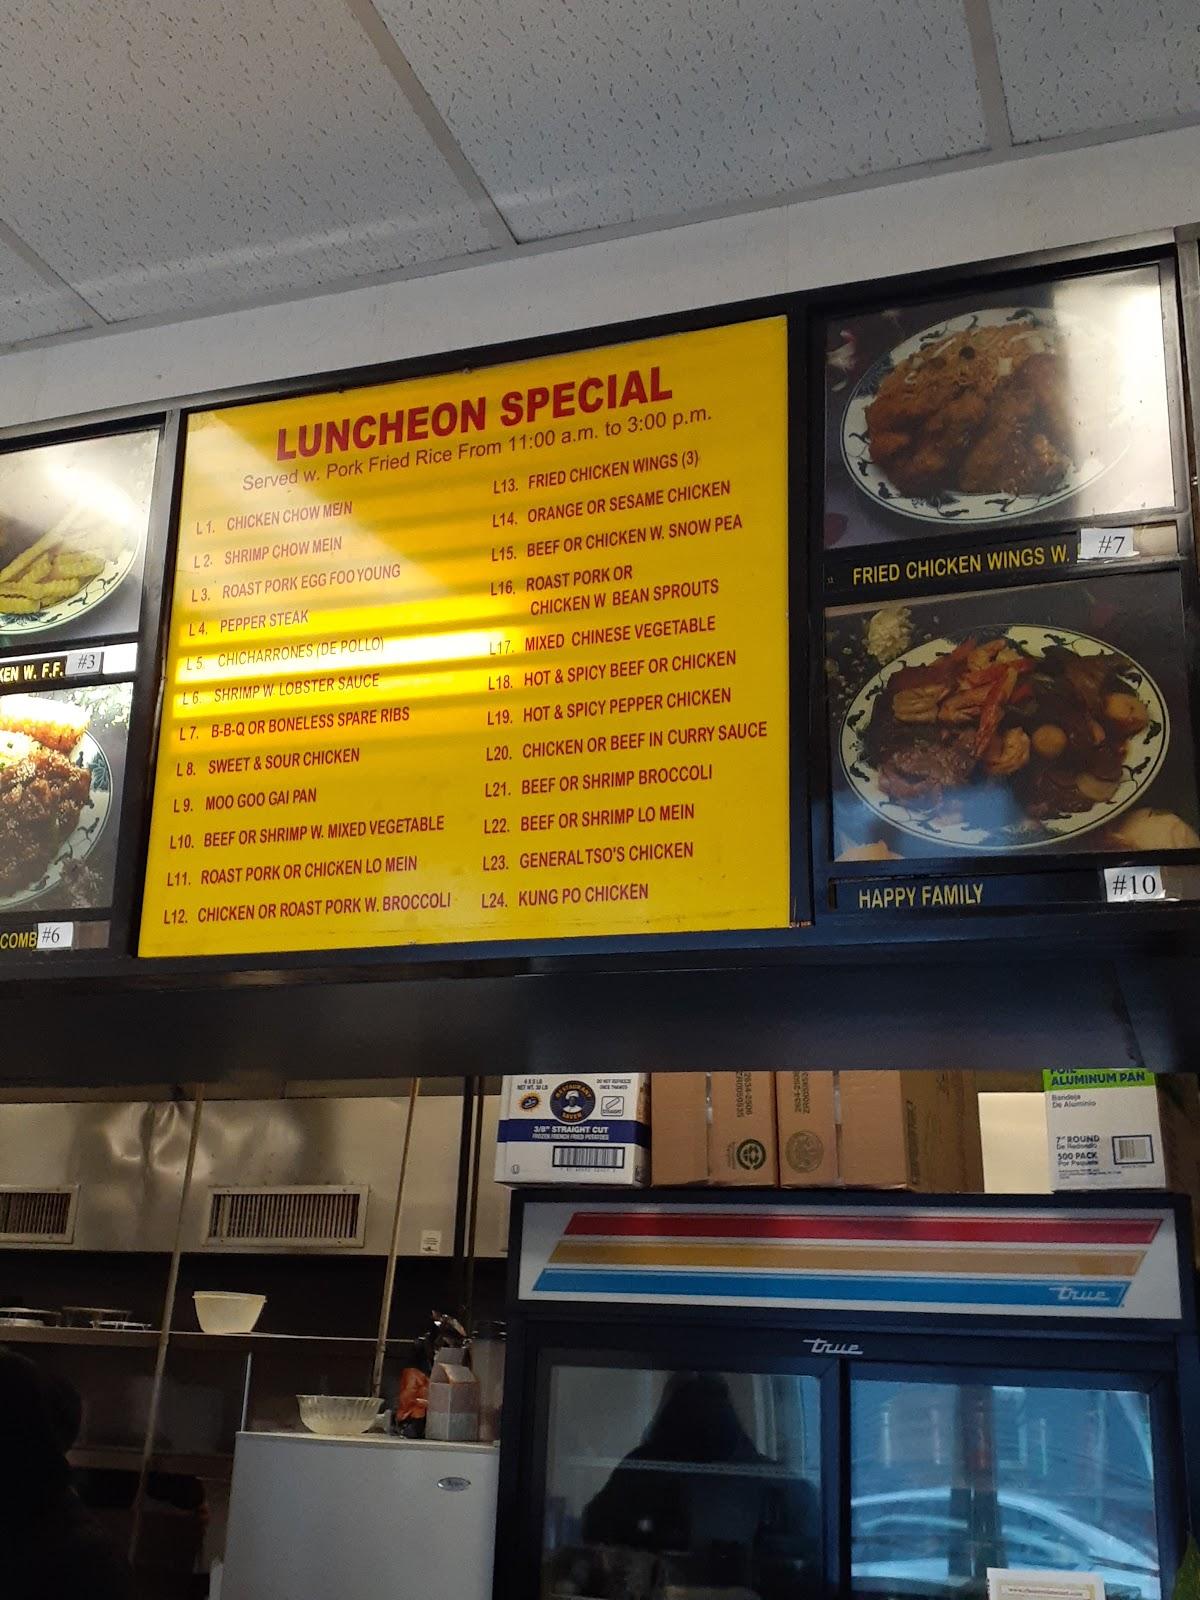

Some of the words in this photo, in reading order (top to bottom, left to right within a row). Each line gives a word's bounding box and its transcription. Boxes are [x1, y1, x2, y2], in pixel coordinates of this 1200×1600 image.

[276, 396, 486, 461] LUNCHEON
[500, 366, 672, 426] SPECIAL
[242, 468, 298, 491] Served
[303, 468, 320, 483] w.
[326, 459, 363, 478] Pork
[368, 451, 410, 472] Fried
[415, 448, 452, 465] Rice
[458, 442, 501, 459] From
[508, 429, 555, 451] 11:00
[560, 427, 598, 443] a.m.
[604, 421, 621, 436] to
[627, 411, 666, 432] 3:00
[672, 408, 711, 429] p.m.
[528, 470, 566, 488] FRIED
[569, 460, 629, 482] CHICKEN
[632, 453, 678, 472] WINGS
[681, 450, 698, 469] (3)
[226, 511, 280, 530] CHICKEN
[282, 505, 320, 523] CHOW
[322, 500, 352, 517] MEIN
[527, 501, 583, 522] ORANGE
[586, 498, 605, 514] OR
[609, 489, 664, 511] SESAME
[667, 480, 730, 502] CHICKEN
[224, 546, 269, 564] SHRIMP
[272, 540, 310, 558] CHOW
[312, 535, 342, 553] MEIN
[526, 539, 560, 557] BEEF
[563, 536, 582, 552] OR
[585, 528, 646, 549] CHICKEN
[668, 518, 711, 538] SNOW
[714, 514, 742, 531] PEA
[1098, 535, 1126, 554] #7
[526, 572, 570, 591] ROAST
[572, 567, 610, 585] PORK
[612, 564, 632, 580] OR
[853, 563, 900, 584] FRIED
[905, 554, 980, 578] CHICKEN
[986, 547, 1044, 569] WINGS
[222, 580, 262, 598] ROAST
[264, 576, 298, 593] PORK
[300, 572, 326, 588] EGG
[329, 569, 354, 584] FOO
[356, 563, 400, 581] YOUNG
[530, 595, 590, 615] CHICKEN
[612, 587, 649, 605] BEAN
[653, 578, 718, 600] SPROUTS
[220, 614, 266, 632] PEPPER
[269, 608, 308, 626] STEAK
[525, 633, 564, 650] MIXED
[571, 625, 631, 646] CHINESE
[634, 615, 715, 638] VEGETABLE
[77, 654, 95, 669] #3
[218, 642, 313, 666] CHICHARRONES
[316, 640, 336, 657] (DE
[340, 635, 385, 652] POLLO)
[23, 664, 37, 681] W.
[41, 661, 64, 679] F.F.
[524, 670, 551, 686] HOT
[554, 668, 563, 683] &
[567, 664, 606, 682] SPICY
[609, 659, 644, 677] BEEF
[648, 657, 668, 673] OR
[671, 650, 736, 670] CHICKEN
[214, 684, 260, 702] SHRIMP
[278, 676, 335, 695] LOBSTER
[337, 672, 380, 689] SAUCE
[523, 705, 550, 722] HOT
[553, 704, 563, 719] &
[566, 700, 606, 718] SPICY
[609, 694, 662, 713] PEPPER
[666, 687, 730, 708] CHICKEN
[211, 721, 244, 737] B-B-Q
[247, 719, 265, 734] OR
[268, 713, 334, 732] BONELESS
[337, 708, 377, 726] SPARE
[380, 706, 410, 722] RIBS
[522, 738, 583, 758] CHICKEN
[586, 736, 606, 752] OR
[610, 732, 645, 750] BEEF
[648, 730, 662, 746] IN
[667, 726, 715, 744] CURRY
[718, 721, 767, 740] SAUCE
[208, 756, 250, 774] SWEET
[253, 755, 262, 770] &
[264, 752, 300, 769] SOUR
[302, 747, 359, 766] CHICKEN
[521, 777, 556, 794] BEEF
[558, 775, 578, 791] OR
[582, 770, 634, 789] SHRIMP
[638, 764, 712, 784] BROCCOLI
[205, 794, 234, 810] MOO
[236, 791, 265, 808] GOO
[268, 790, 289, 805] GAI
[292, 787, 316, 803] PAN
[203, 830, 236, 847] BEEF
[238, 829, 256, 844] OR
[259, 825, 307, 843] SHRIMP
[327, 821, 366, 838] MIXED
[368, 815, 444, 834] VEGETABLE
[520, 814, 555, 831] BEEF
[558, 812, 578, 828] OR
[581, 808, 634, 826] SHRIMP
[638, 806, 655, 822] LO
[659, 803, 694, 820] MEIN
[628, 841, 693, 860] CHICKEN
[200, 867, 242, 884] ROAST
[244, 865, 280, 881] PORK
[282, 863, 301, 879] OR
[304, 859, 362, 877] CHICKEN
[365, 857, 382, 873] LO
[384, 855, 417, 872] MEIN
[518, 888, 558, 906] KUNG
[562, 887, 581, 904] PO
[584, 883, 648, 902] CHICKEN
[858, 886, 916, 908] HAPPY
[921, 883, 983, 905] FAMILY
[1112, 874, 1156, 895] #10
[197, 904, 254, 922] CHICKEN
[257, 903, 276, 919] OR
[279, 899, 322, 916] ROAST
[324, 897, 361, 914] PORK
[382, 892, 450, 911] BROCCOLI
[0, 931, 38, 949] COMB
[41, 927, 61, 944] #6
[1052, 1074, 1116, 1085] ALUMINUM
[1120, 1072, 1145, 1082] PAN
[1050, 1286, 1110, 1300] true
[803, 1338, 863, 1355] true
